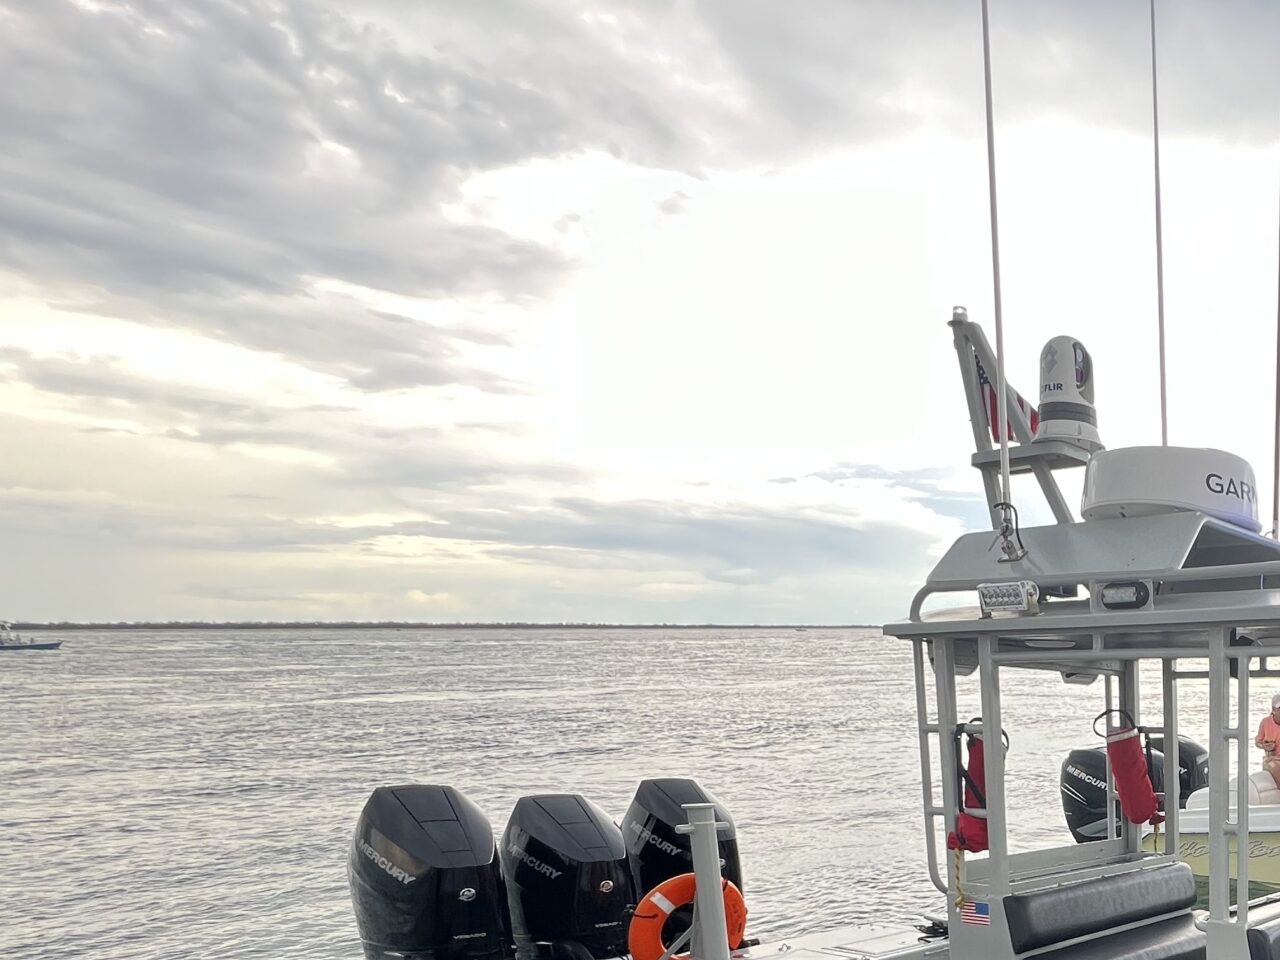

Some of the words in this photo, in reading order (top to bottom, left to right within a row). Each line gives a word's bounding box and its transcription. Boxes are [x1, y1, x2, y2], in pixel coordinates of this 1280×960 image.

[630, 821, 683, 856] MERCURY
[360, 839, 417, 885] MERCURY
[507, 843, 563, 879] MERCURY
